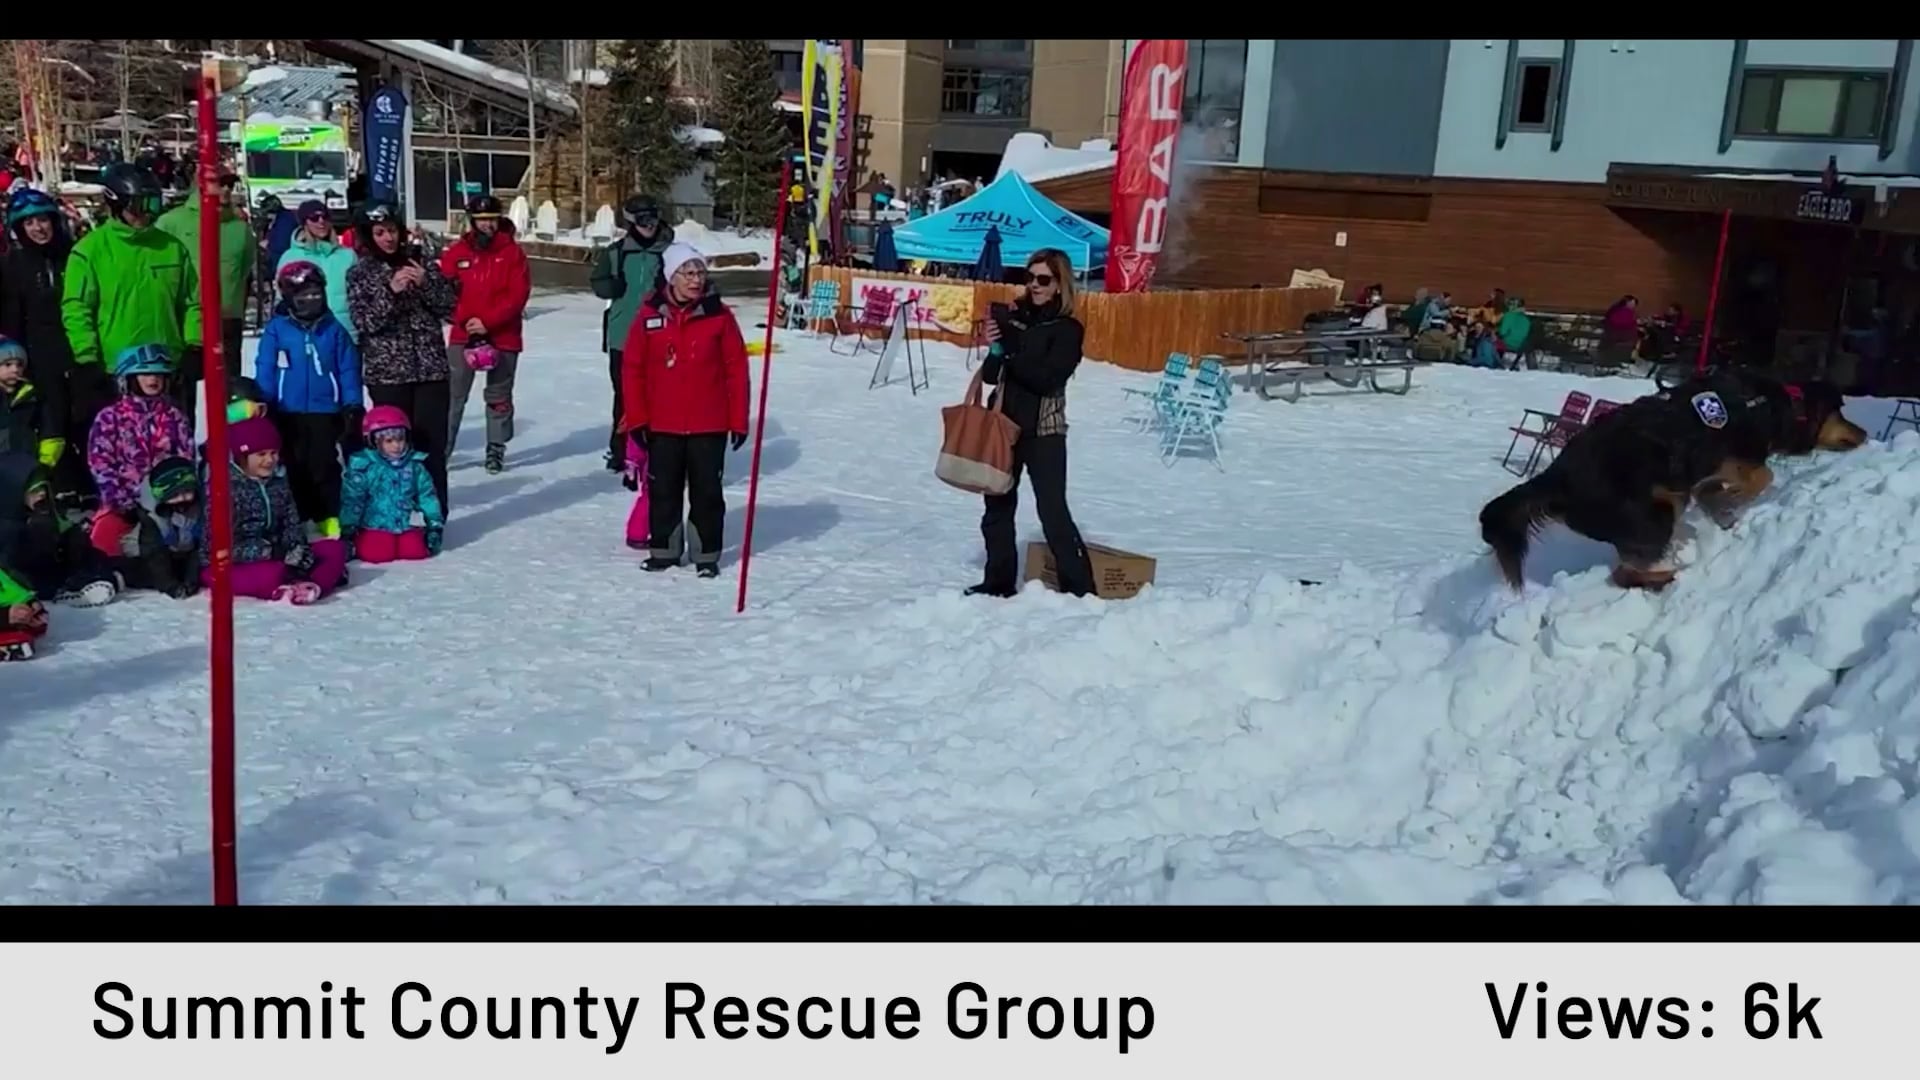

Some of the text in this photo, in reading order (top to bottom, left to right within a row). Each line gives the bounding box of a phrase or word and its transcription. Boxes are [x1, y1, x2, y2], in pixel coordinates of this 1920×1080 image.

[374, 137, 388, 183] Private
[1136, 63, 1184, 253] BAR
[955, 210, 1032, 229] TRULY
[1797, 192, 1828, 219] EAGLE
[1828, 198, 1852, 221] BBQ
